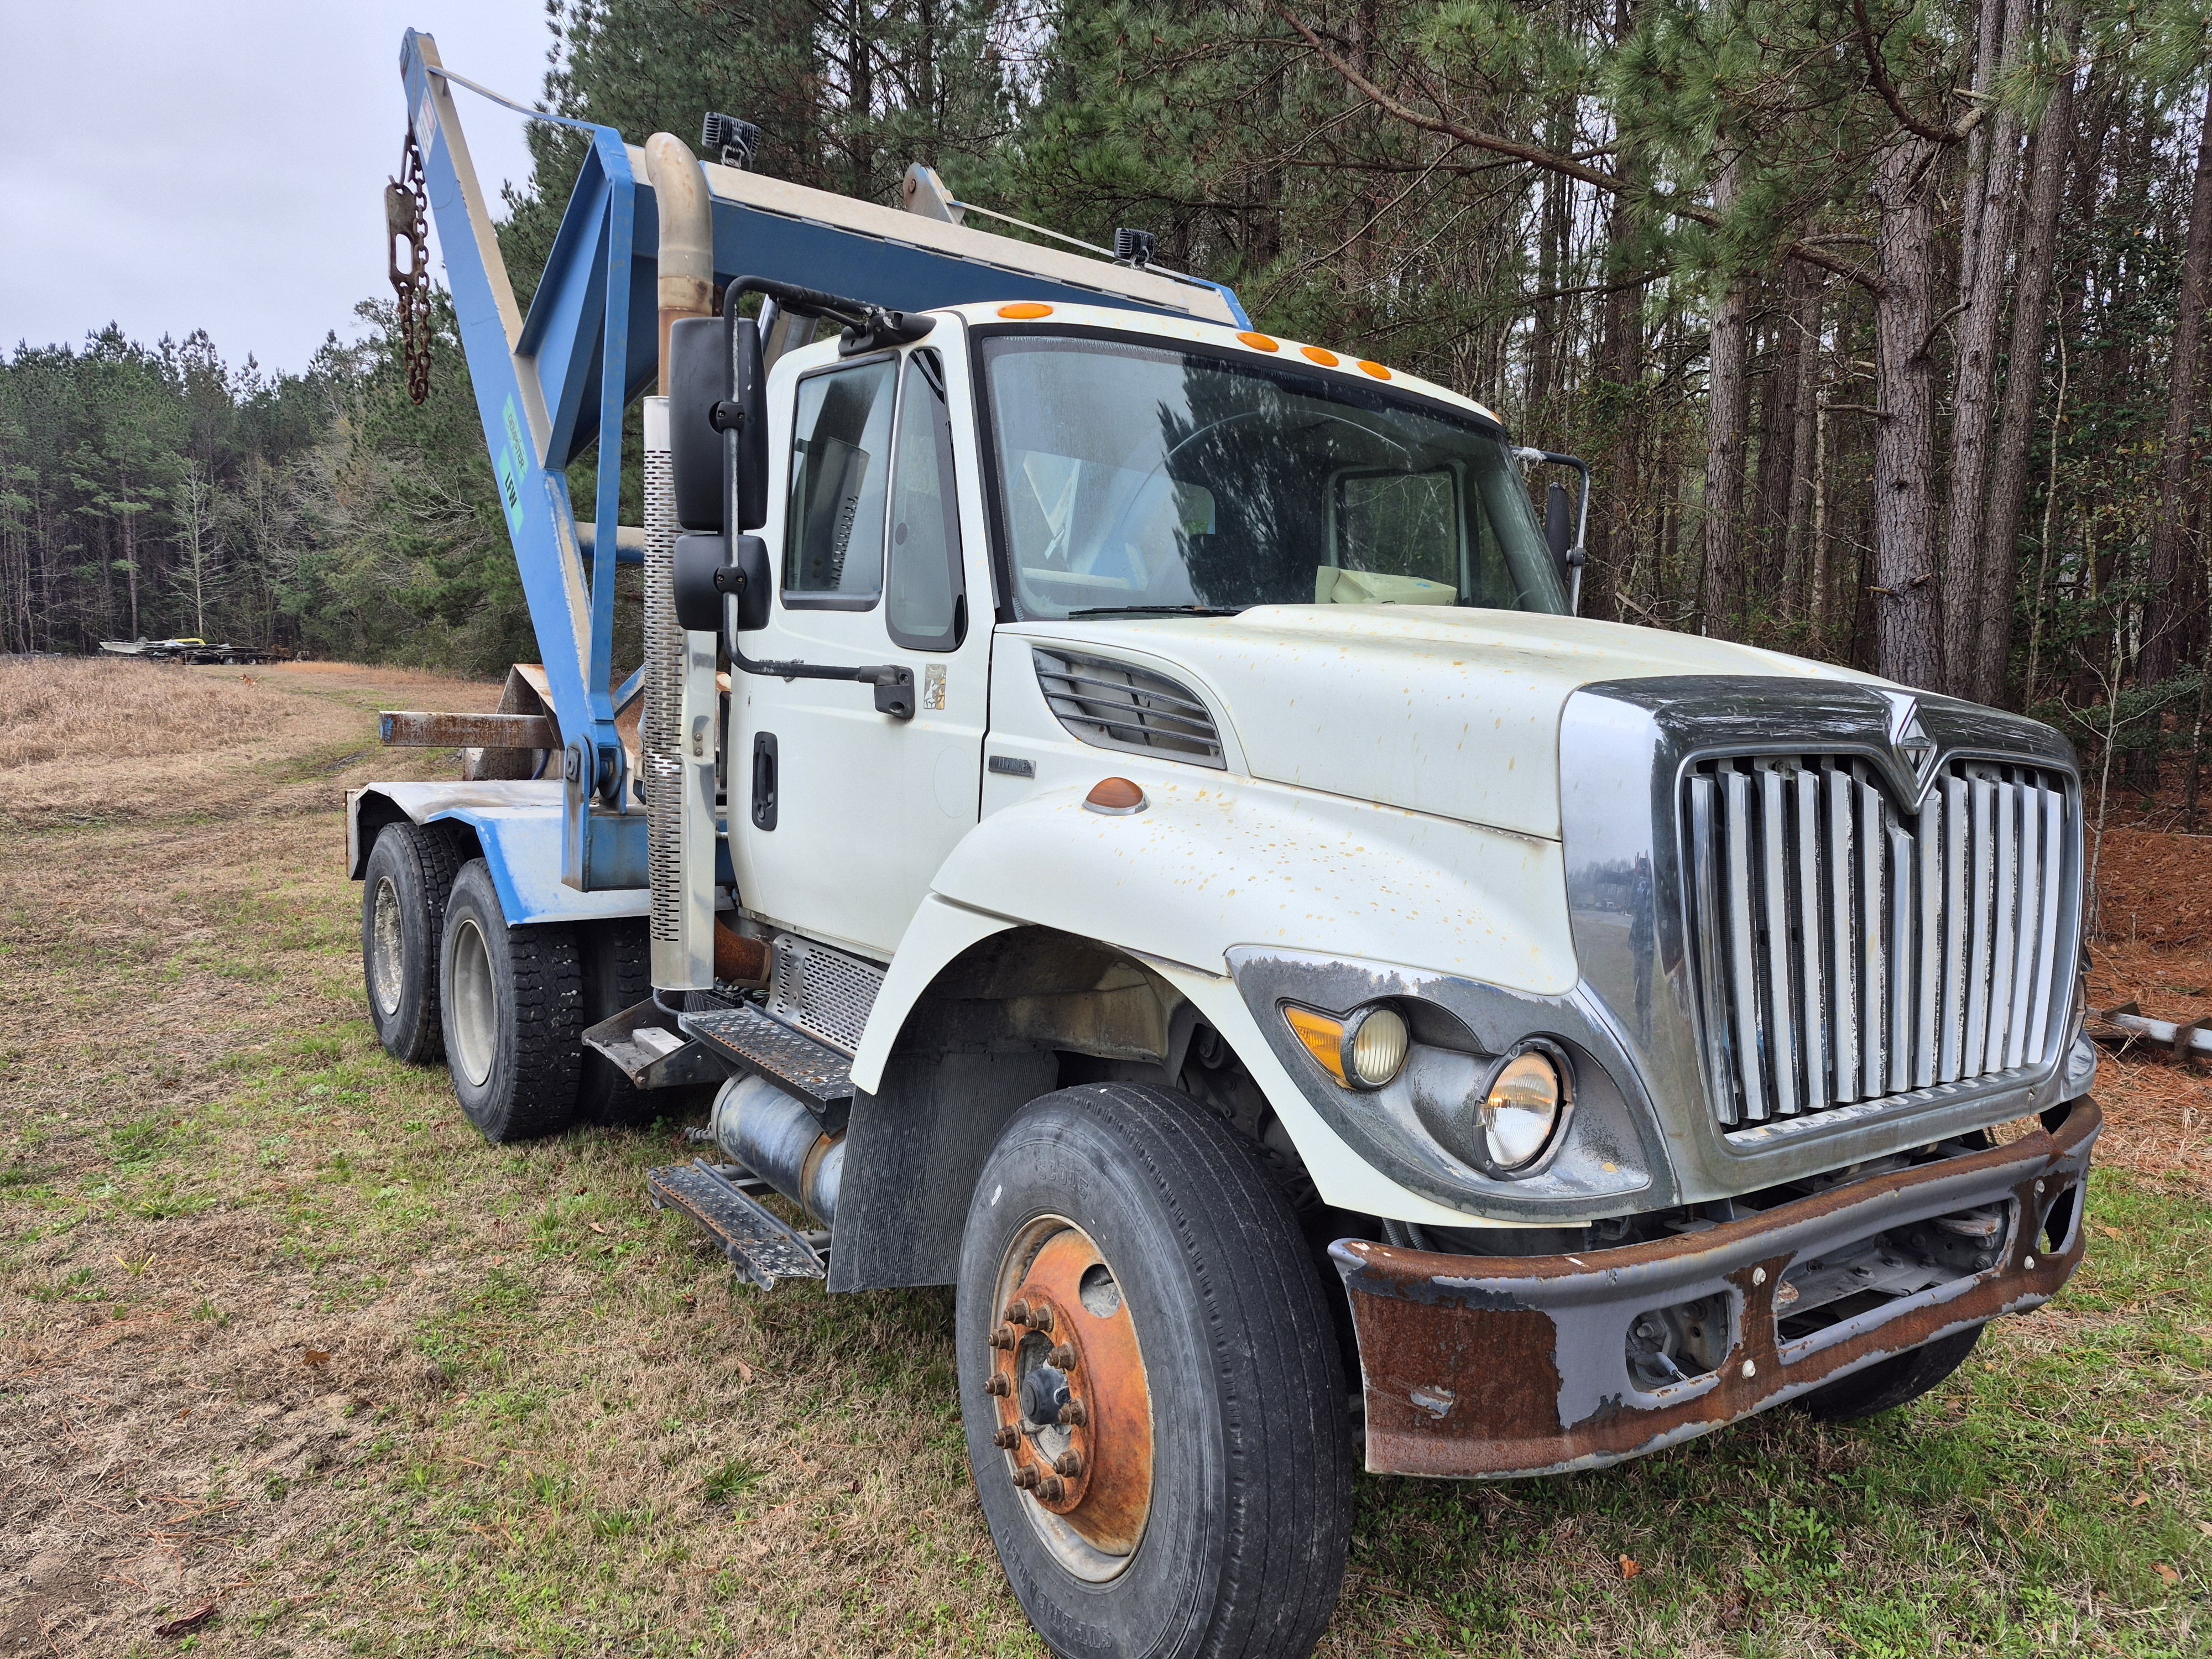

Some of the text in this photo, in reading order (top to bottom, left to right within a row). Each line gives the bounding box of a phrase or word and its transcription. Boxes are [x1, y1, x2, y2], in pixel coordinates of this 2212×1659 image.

[508, 413, 524, 469] DEMPSTER
[505, 471, 517, 509] LFW
[1002, 1527, 1113, 1649] SUPERCARGO
